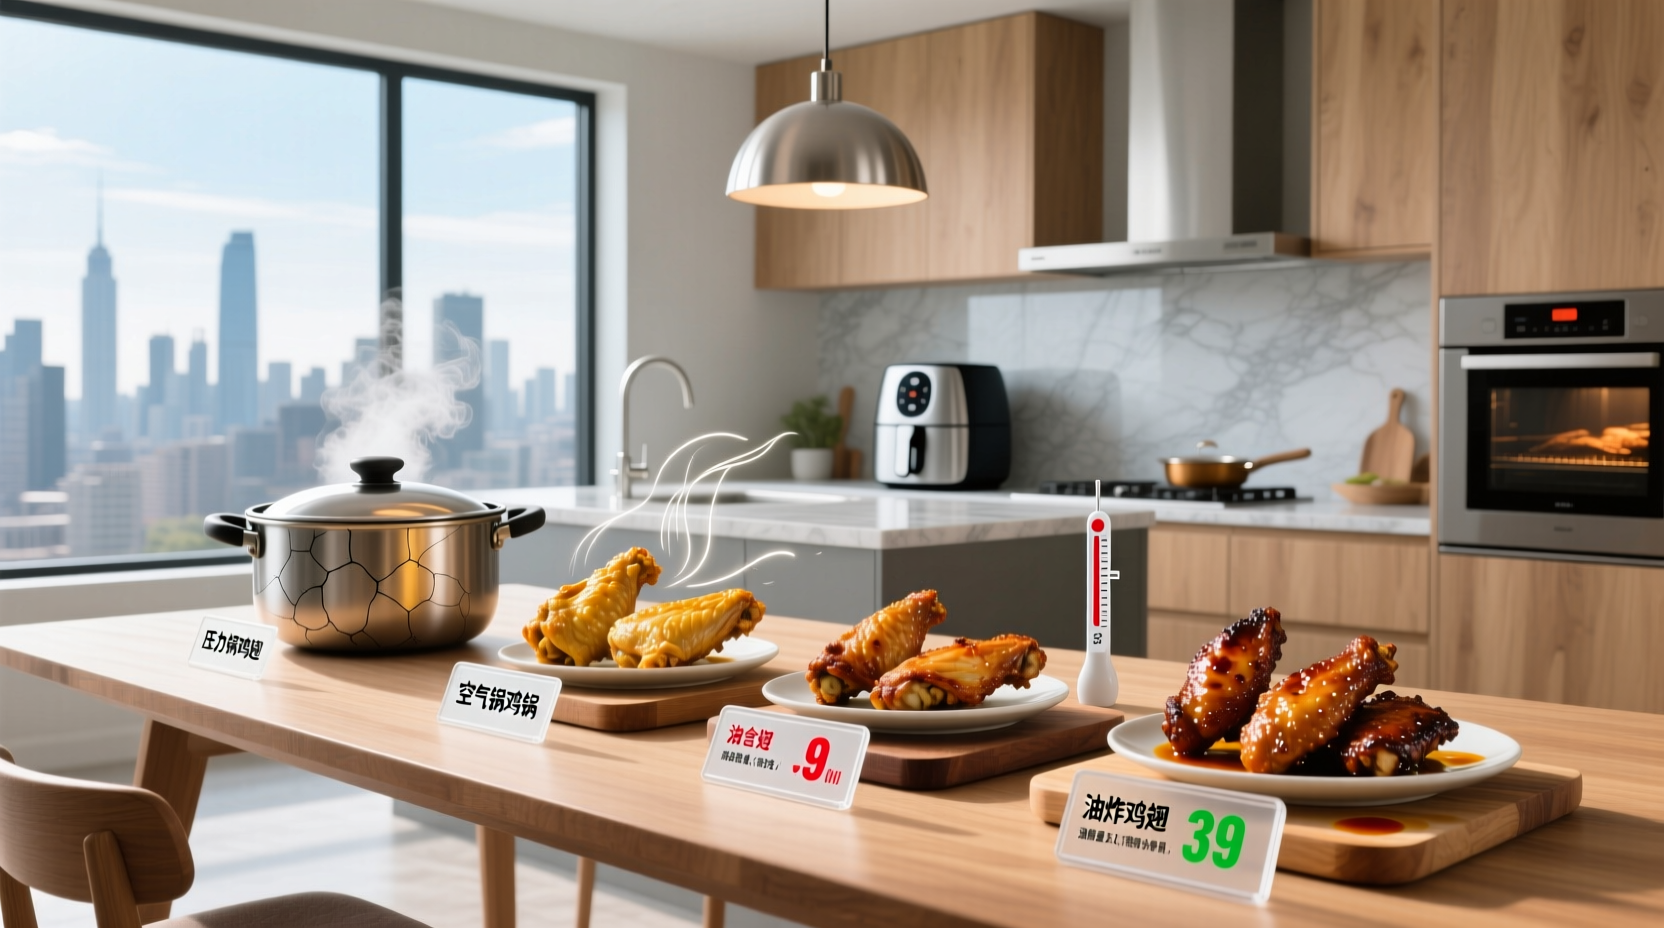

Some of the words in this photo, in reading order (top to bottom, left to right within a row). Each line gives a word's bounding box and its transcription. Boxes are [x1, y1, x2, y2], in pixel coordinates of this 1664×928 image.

[1082, 793, 1170, 832] 油炸鸡翅
[1182, 809, 1246, 869] 39
